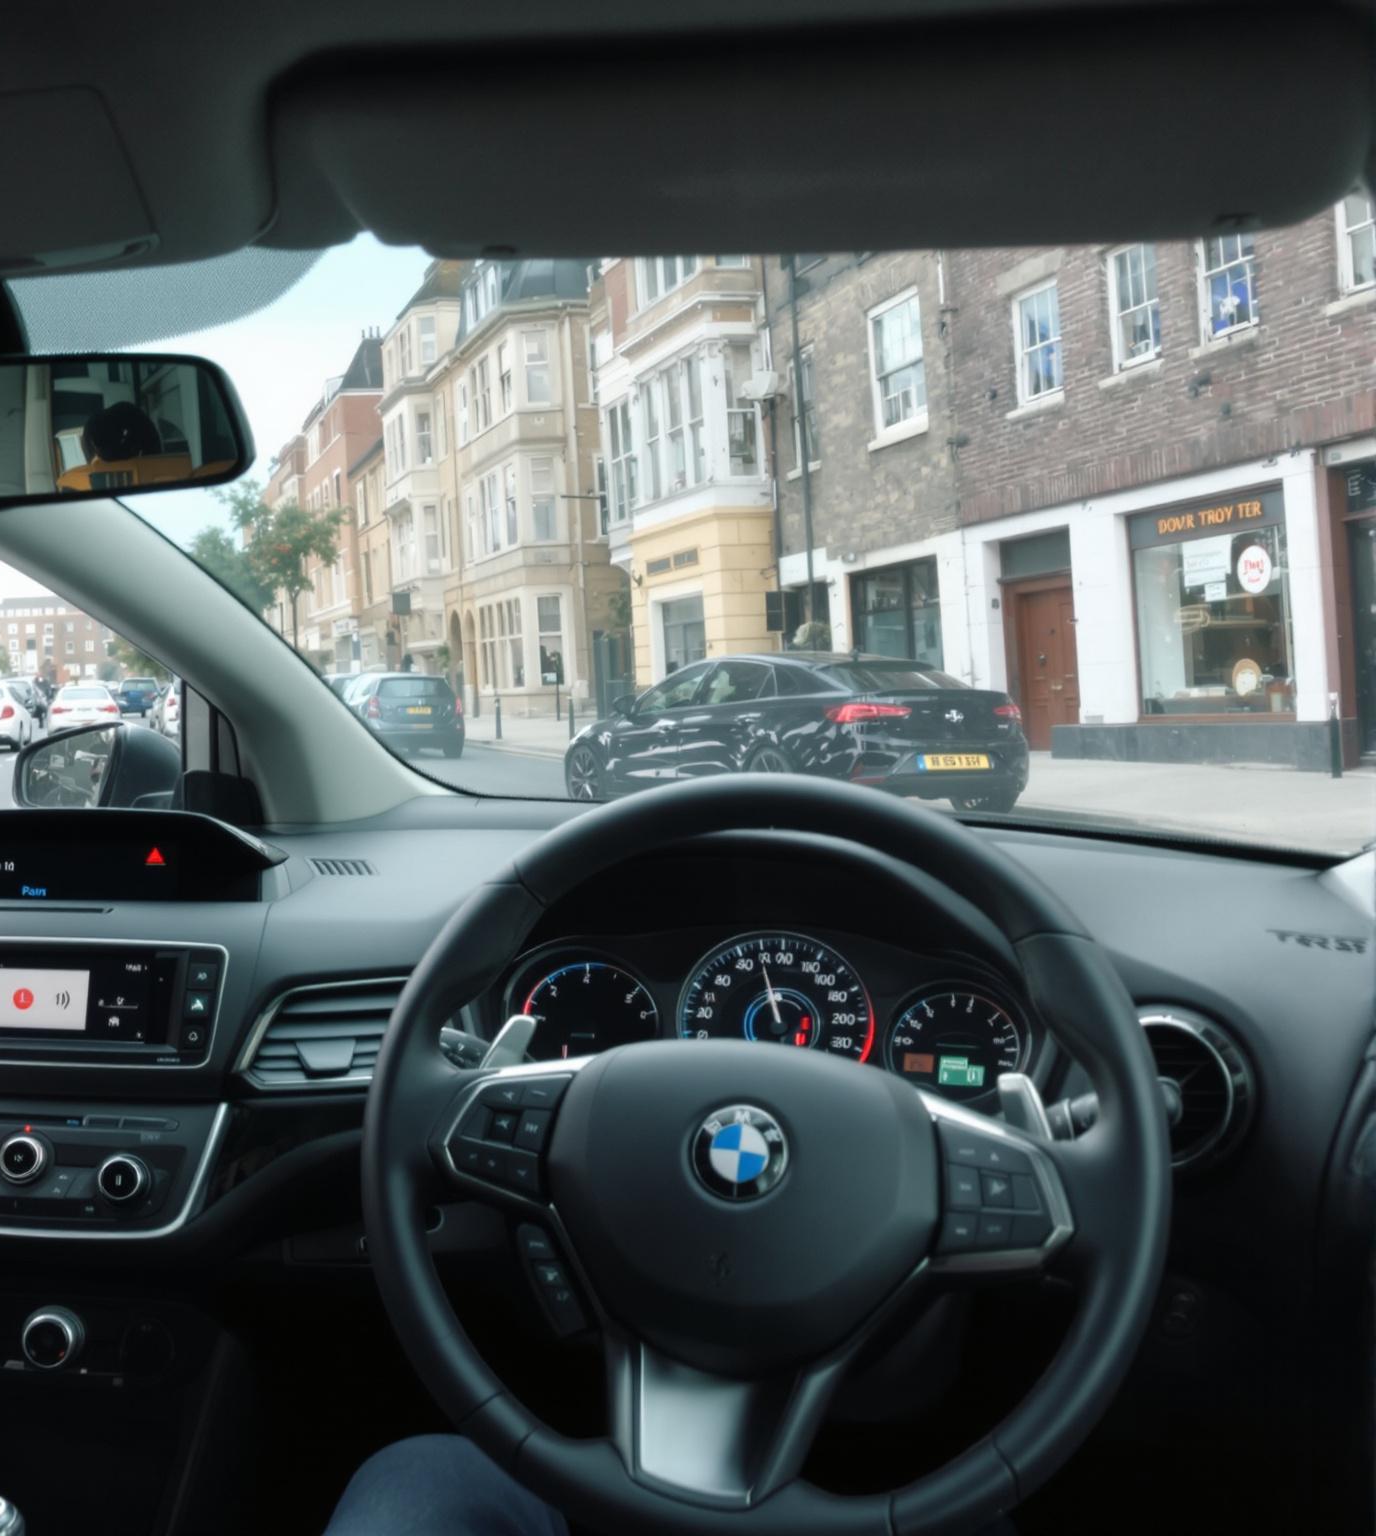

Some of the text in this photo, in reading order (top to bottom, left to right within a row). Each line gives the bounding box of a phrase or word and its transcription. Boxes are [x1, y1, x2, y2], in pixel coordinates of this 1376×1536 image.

[1198, 505, 1233, 526] TROY
[1237, 500, 1262, 518] TER
[832, 1013, 856, 1026] 200
